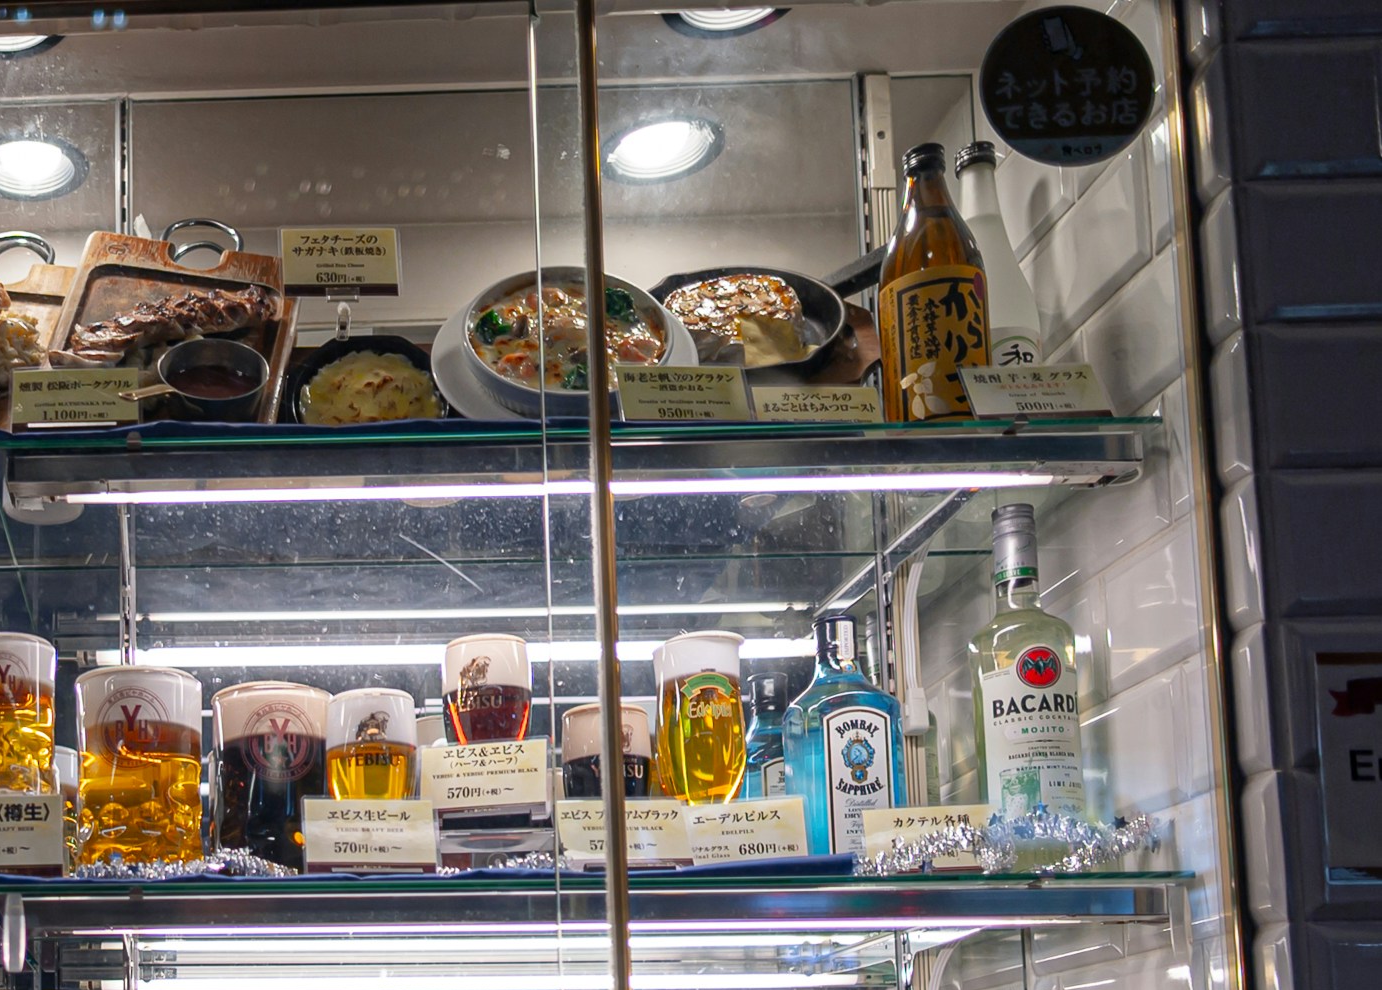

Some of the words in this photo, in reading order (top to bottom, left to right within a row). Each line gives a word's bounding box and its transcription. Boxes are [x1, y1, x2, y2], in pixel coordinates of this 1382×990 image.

[995, 66, 1138, 99] ネット予約
[997, 98, 1138, 130] できるお店
[300, 234, 378, 245] フェタチーズの
[999, 344, 1034, 366] 和
[1049, 371, 1087, 380] グラス
[782, 393, 852, 401] カマンベールの
[763, 402, 876, 413] まるごとはちみつロースト
[835, 719, 880, 738] BOMBAY
[1021, 726, 1065, 735] MOJITO
[835, 776, 884, 796] SAPPHIRE
[738, 841, 800, 856] 680円(+税)
